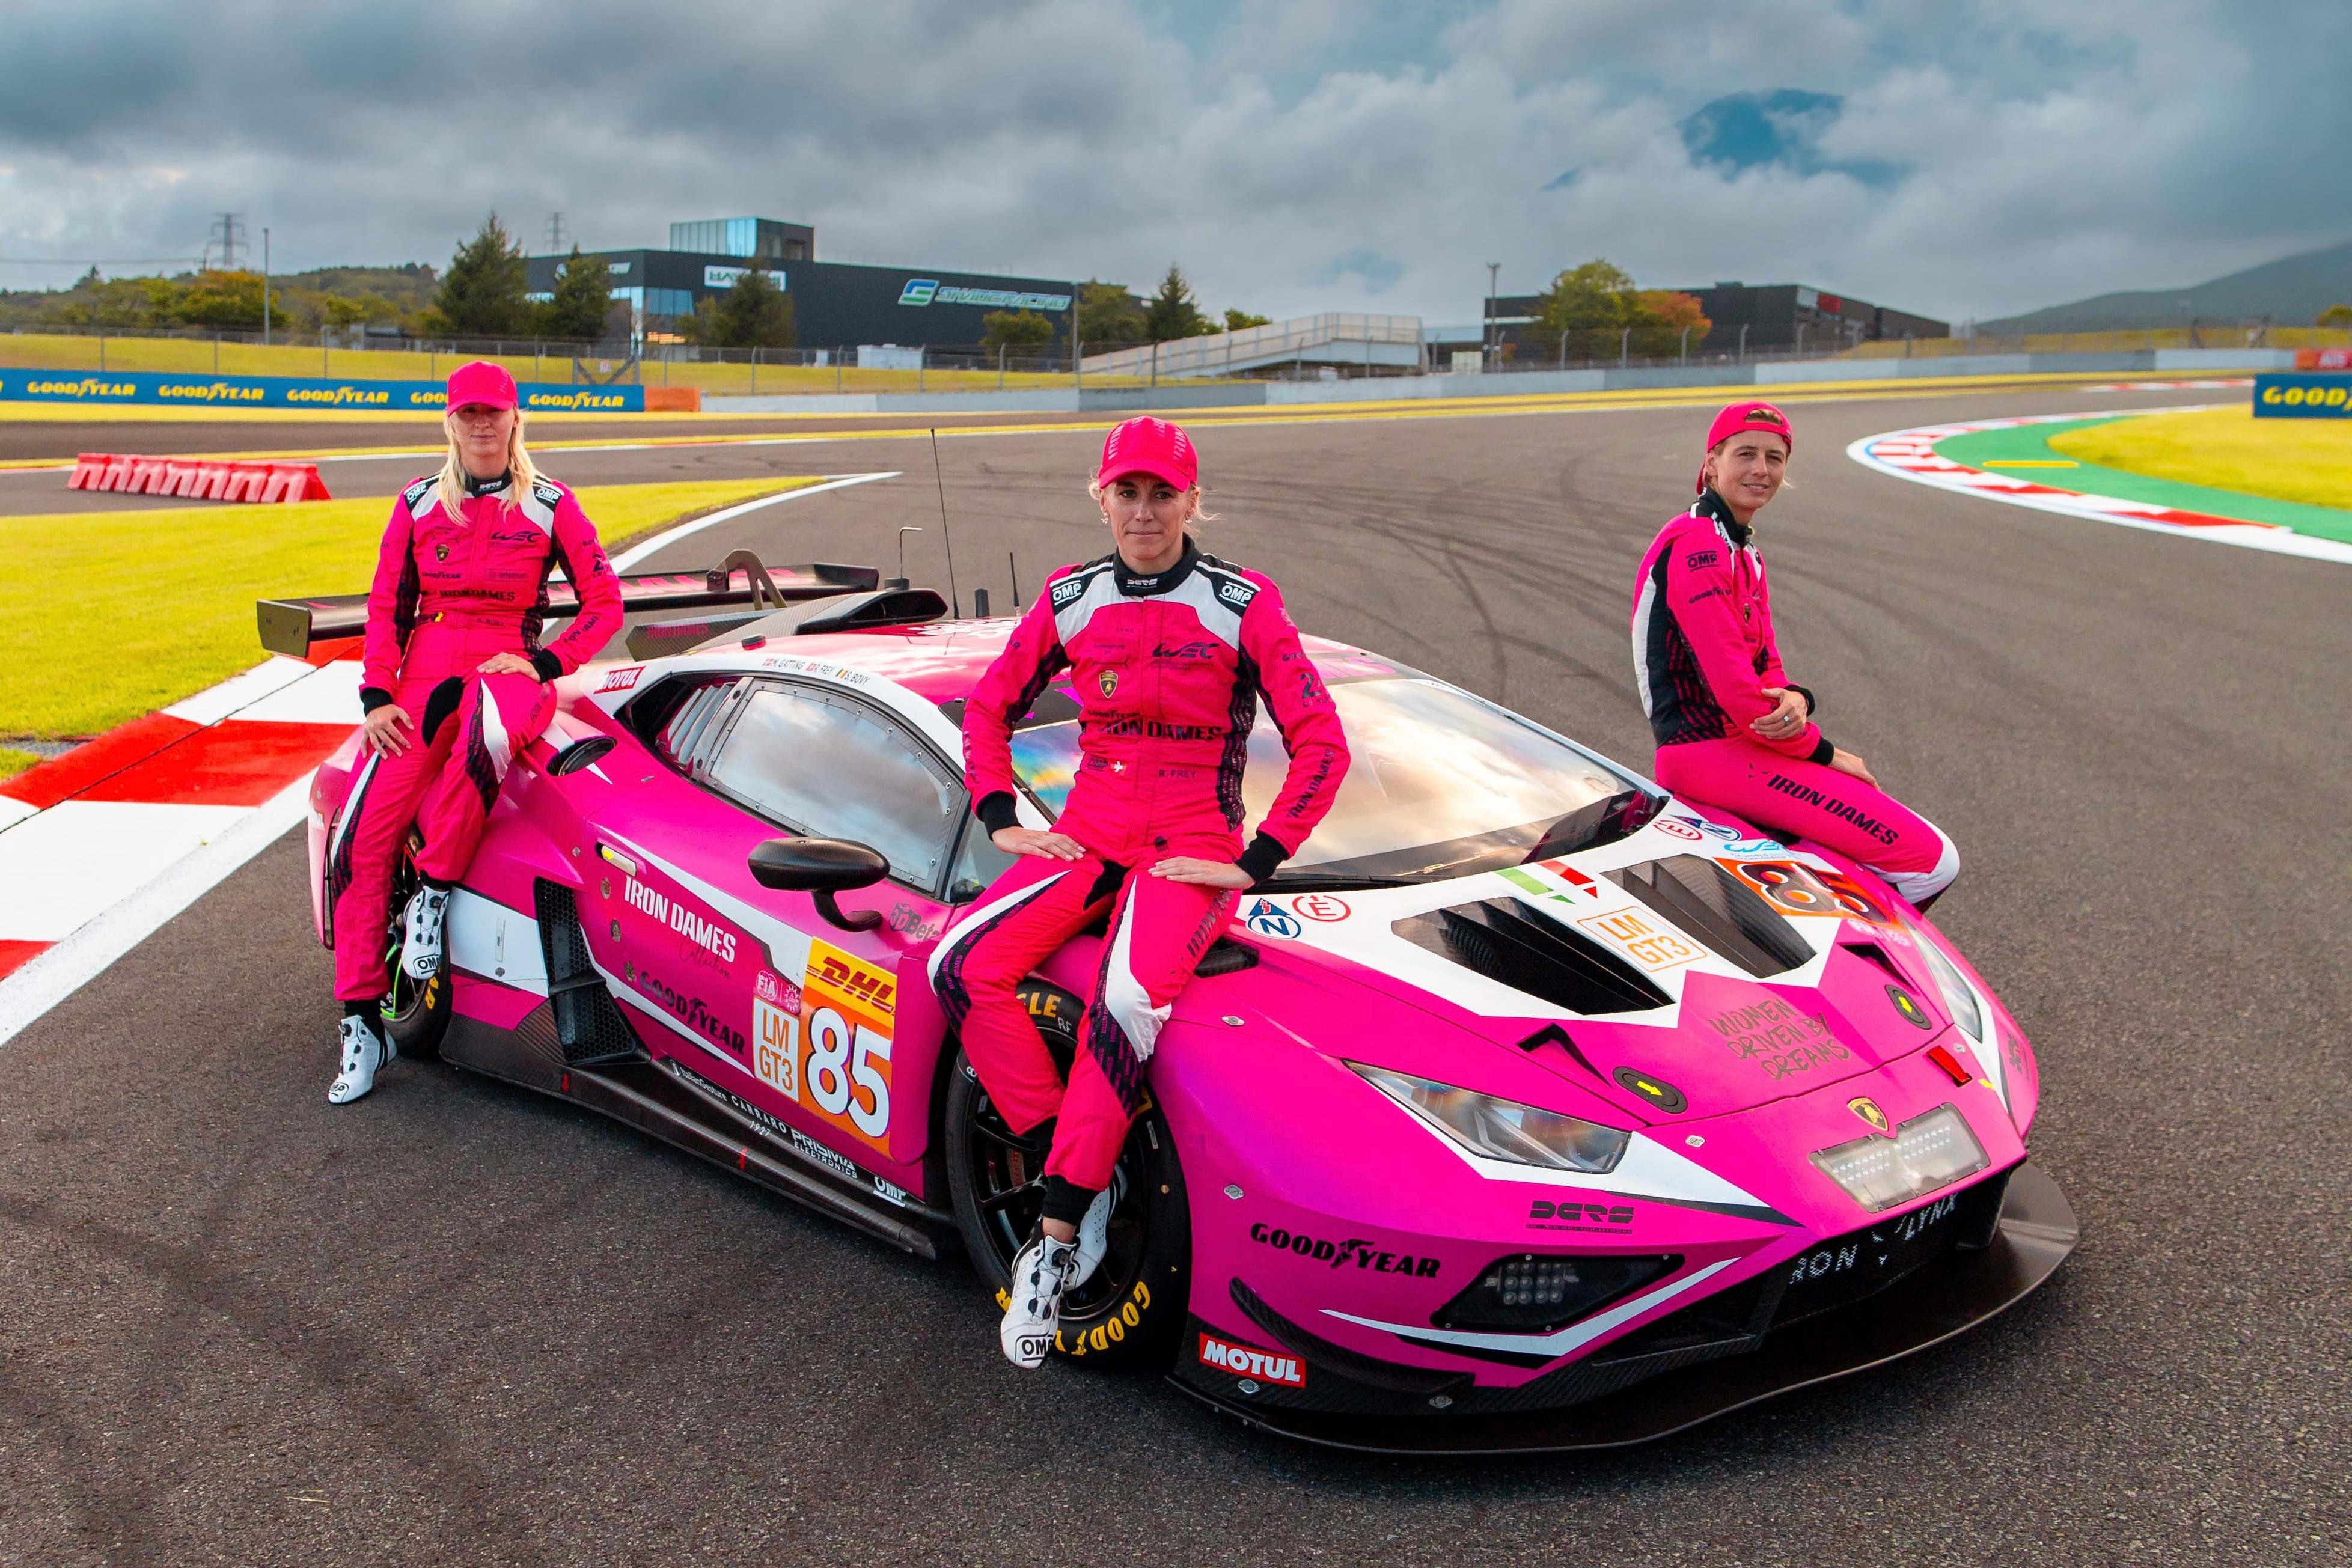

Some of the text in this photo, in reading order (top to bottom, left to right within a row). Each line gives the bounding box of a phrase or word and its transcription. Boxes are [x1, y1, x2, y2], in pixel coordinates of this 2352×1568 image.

[27, 379, 136, 397] GOODYEAR
[158, 383, 264, 401] GOODYEAR
[287, 386, 389, 404] GOODYEAR
[529, 392, 624, 409] GOODYEAR
[2262, 386, 2352, 412] GOOD
[537, 489, 559, 501] OMP
[491, 531, 541, 543] WEC
[1687, 554, 1717, 568] OMP
[1053, 583, 1081, 601] OMP
[1221, 585, 1252, 602] OMP
[1152, 642, 1220, 659] WEC
[600, 670, 636, 690] MOTUL
[1147, 721, 1222, 740] DAMES
[1767, 773, 1900, 846] IRON DAMES
[625, 875, 736, 963] IRON DAMES
[1596, 914, 1655, 941] LM
[1627, 935, 1691, 964] GT3
[819, 956, 894, 1011] DHL
[640, 971, 745, 1055] GOODYEAR
[1708, 998, 1798, 1037] WOMEN
[762, 1008, 790, 1053] LM
[1726, 1012, 1832, 1059] DRIVEN BY
[759, 1045, 793, 1091] GT3
[805, 1005, 893, 1138] 85
[1761, 1038, 1850, 1081] DREAMS
[731, 1095, 787, 1133] CARRARO
[749, 1121, 771, 1137] 1927
[790, 1129, 856, 1171] PRISMA
[795, 1141, 857, 1179] ELECTRONICS
[1250, 1222, 1441, 1278] GOODYEAR
[1203, 1340, 1301, 1383] MOTUL
